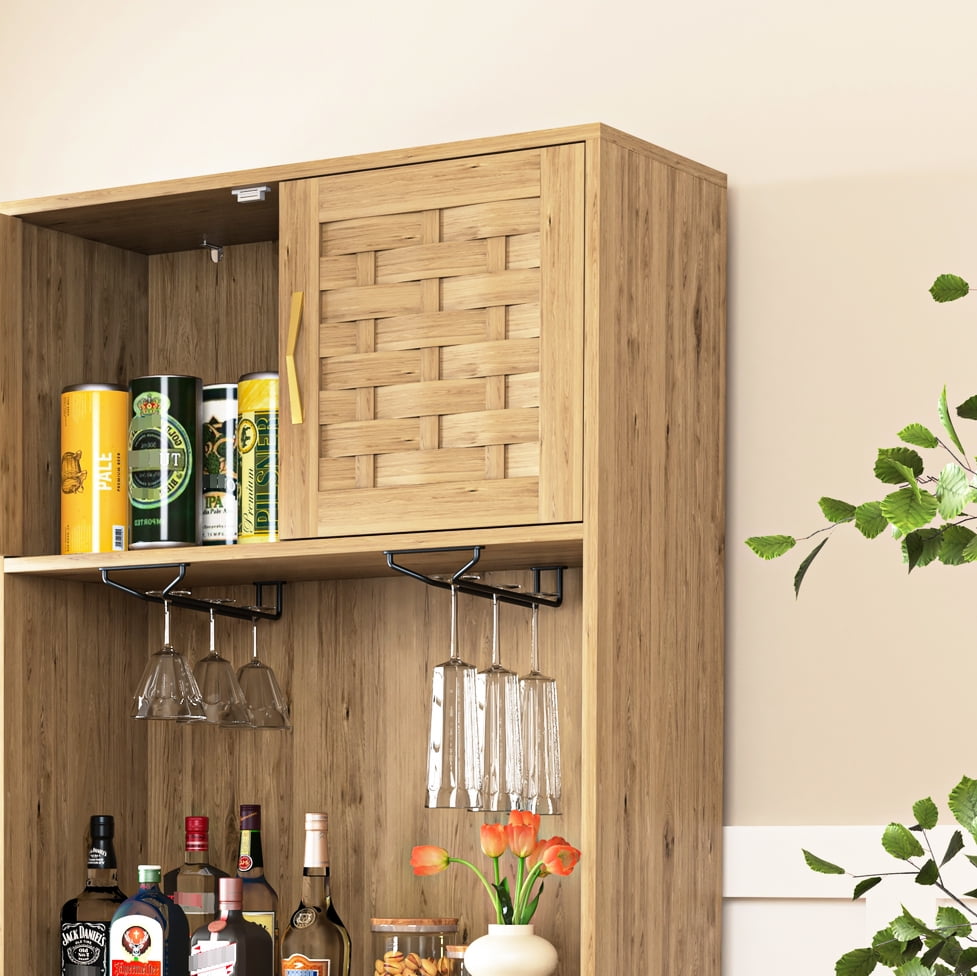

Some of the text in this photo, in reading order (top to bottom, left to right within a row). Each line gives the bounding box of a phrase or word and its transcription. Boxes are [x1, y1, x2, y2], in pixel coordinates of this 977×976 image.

[95, 452, 113, 492] PALE
[256, 417, 279, 530] PILSNER
[206, 496, 224, 509] IPA
[243, 468, 254, 533] Premium
[62, 925, 106, 947] JACK DANIEL'S
